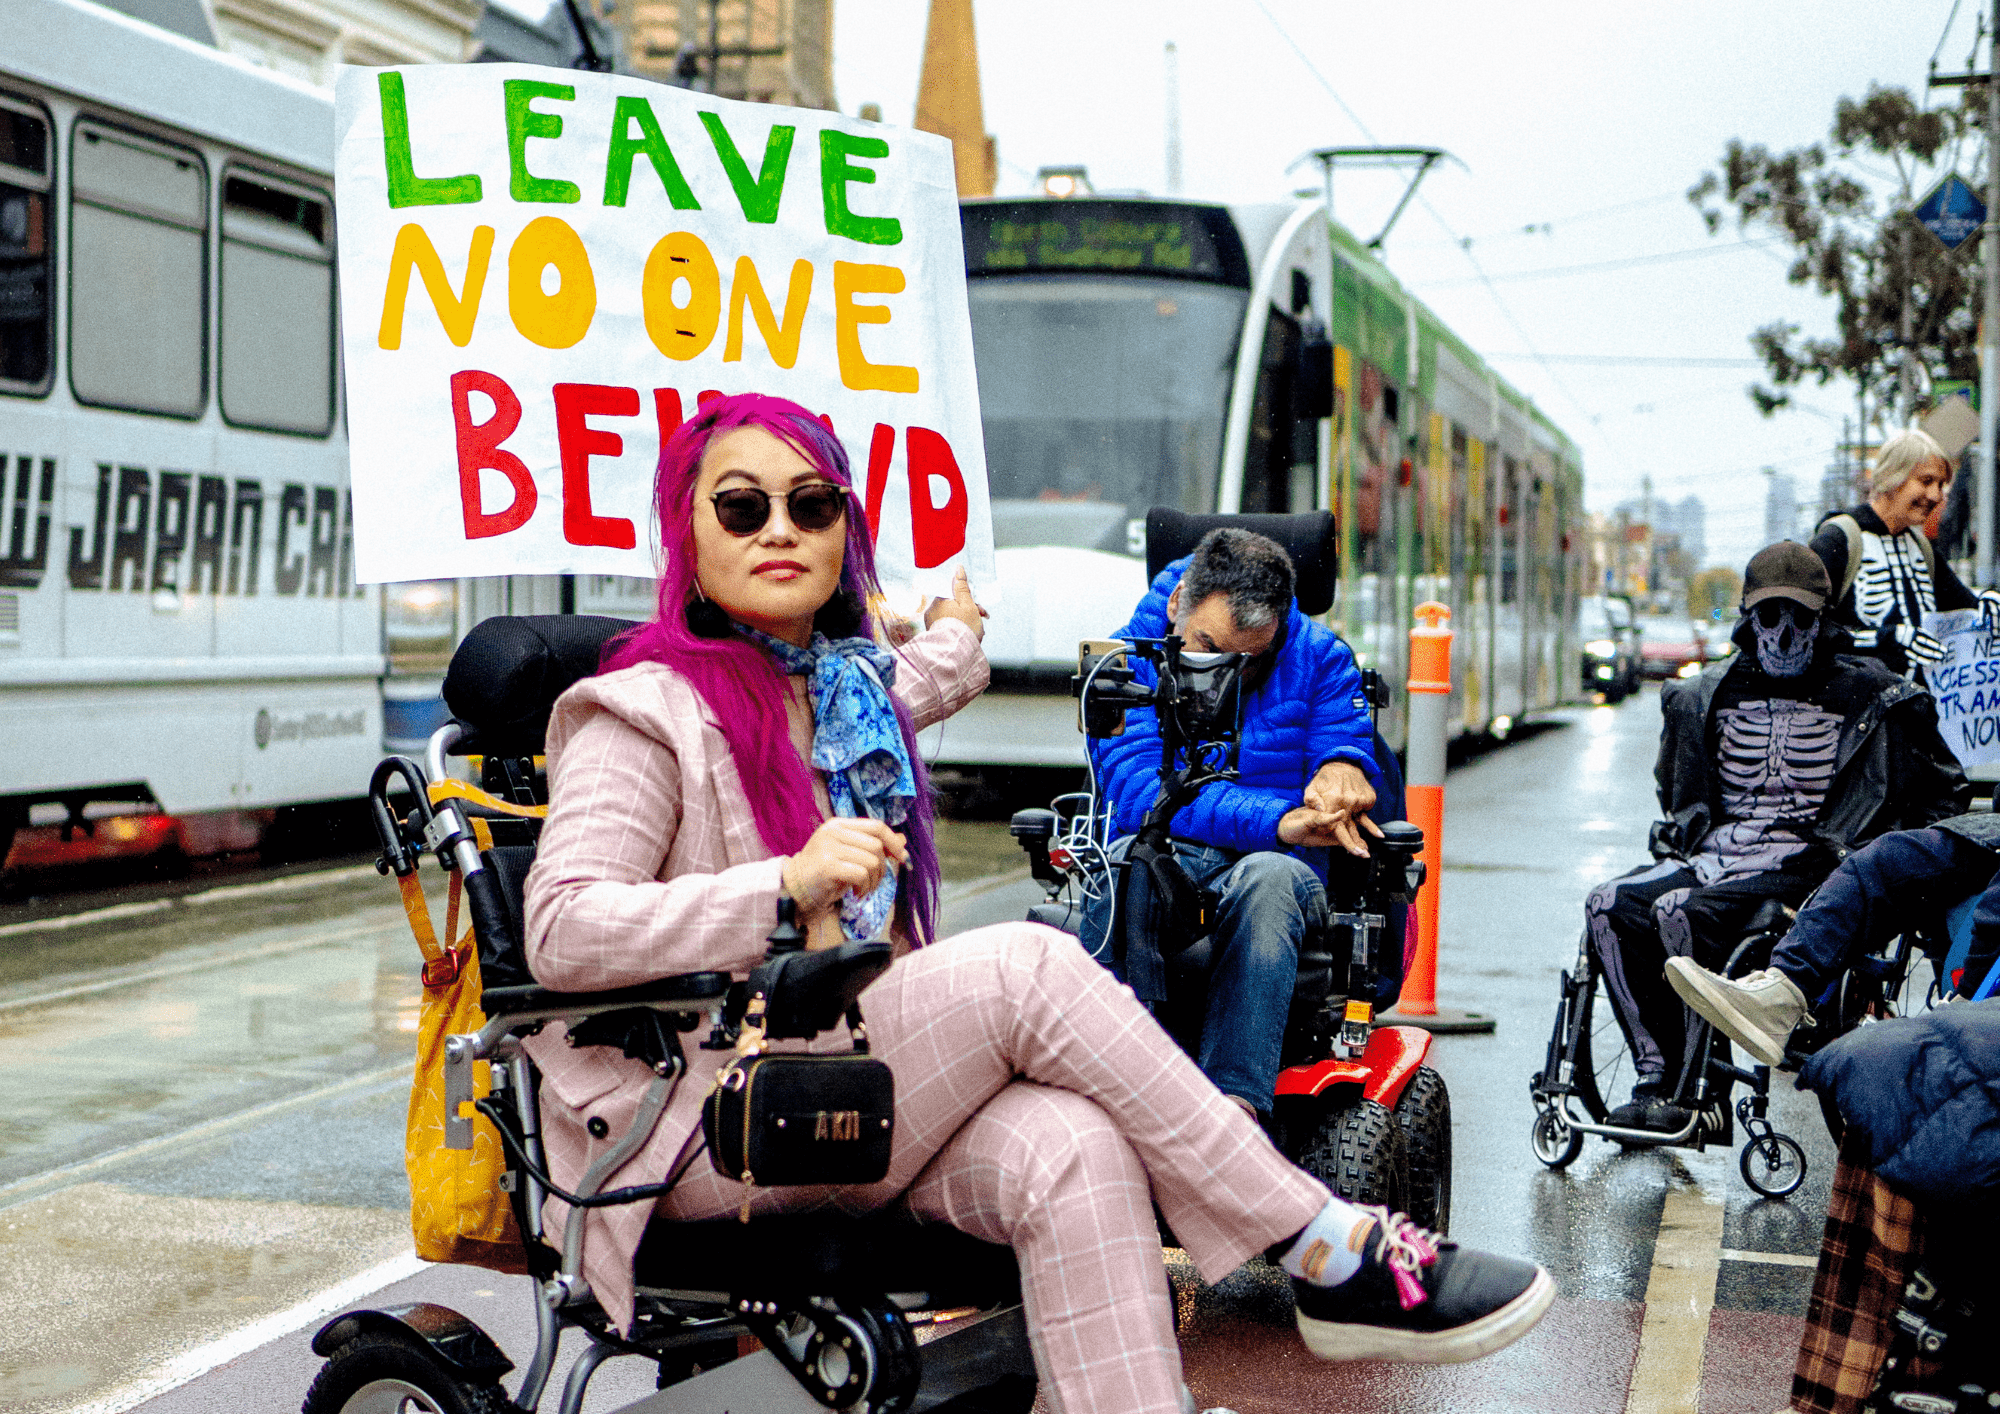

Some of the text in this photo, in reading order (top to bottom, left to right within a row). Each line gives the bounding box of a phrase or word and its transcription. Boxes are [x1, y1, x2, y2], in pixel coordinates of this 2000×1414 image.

[377, 71, 902, 245] LEAVE
[377, 215, 919, 394] NO ONE
[67, 461, 264, 597] JAPAN
[450, 369, 969, 569] BED
[1962, 716, 2000, 751] NO
